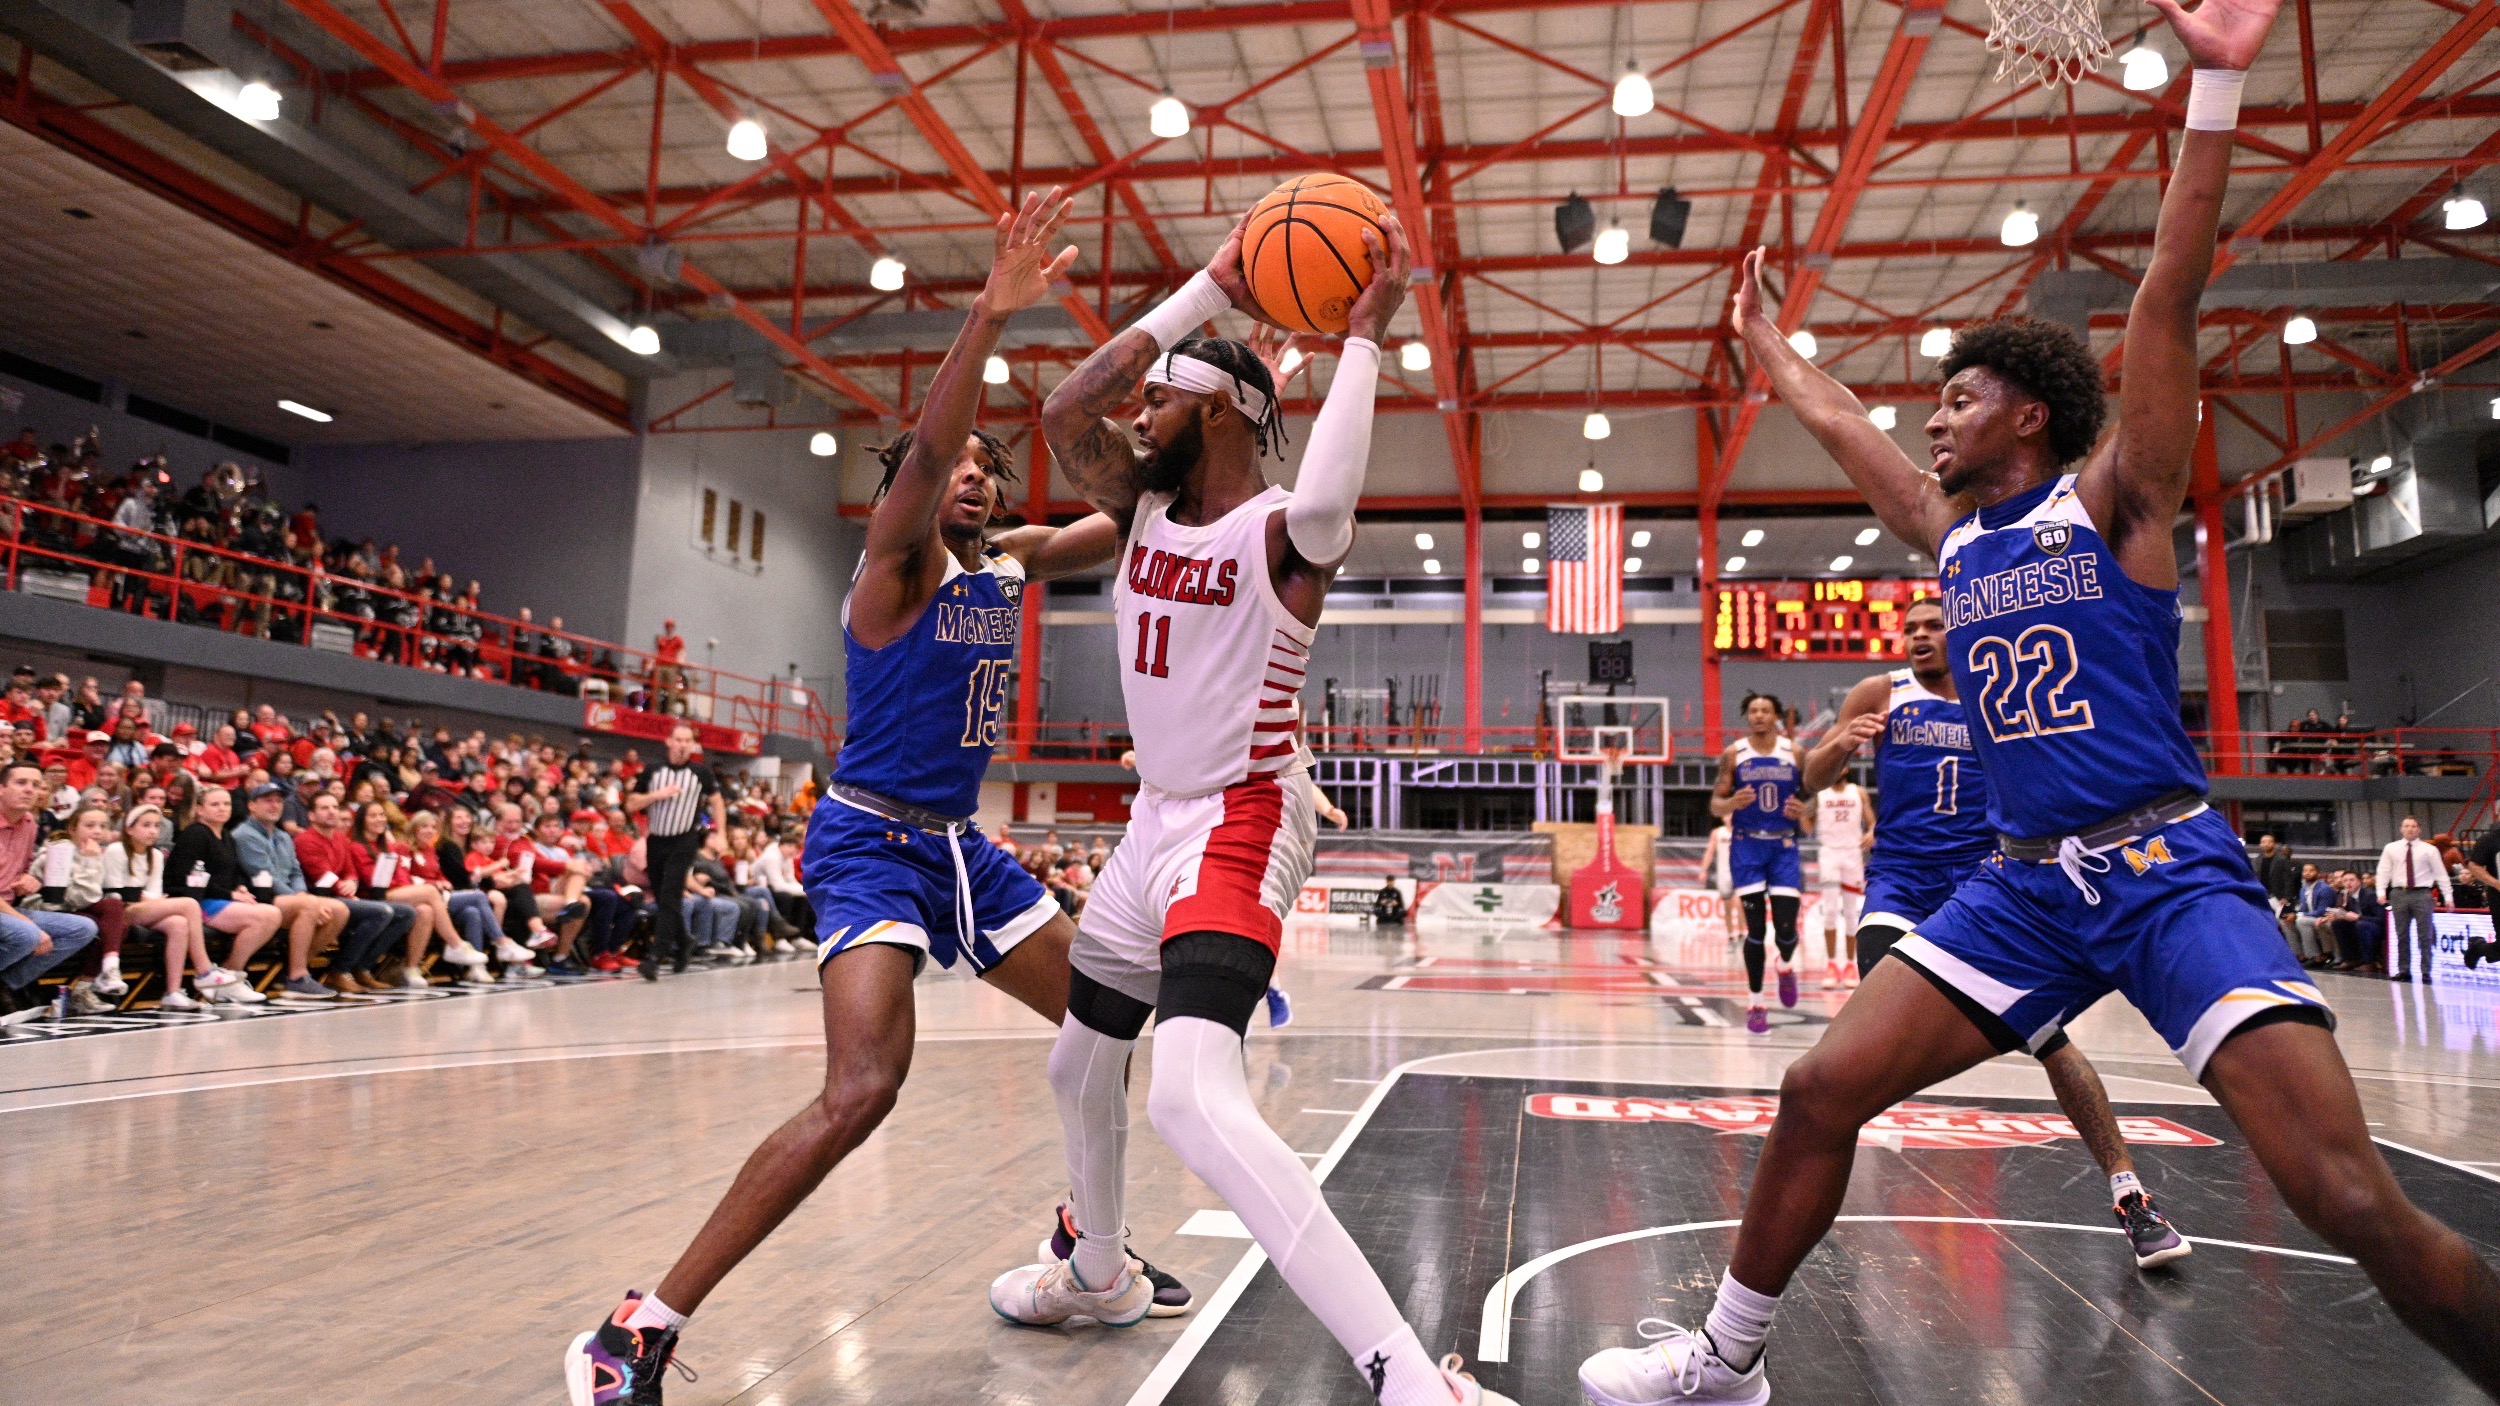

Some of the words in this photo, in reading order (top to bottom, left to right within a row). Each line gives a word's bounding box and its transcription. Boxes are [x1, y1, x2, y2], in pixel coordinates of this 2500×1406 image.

[2041, 529, 2067, 547] 60
[1005, 584, 1019, 598] 60
[1129, 540, 1238, 606] LONELS
[1942, 552, 2103, 633] McNEESE
[936, 603, 1020, 645] McNEES
[1134, 611, 1171, 678] 11
[961, 659, 1012, 747] 15
[1969, 624, 2095, 743] 22
[1891, 718, 1973, 750] McNEE
[1758, 781, 1779, 813] 0
[1934, 755, 1959, 816] 1
[1431, 852, 1477, 882] N
[2121, 835, 2179, 877] M
[1332, 891, 1379, 903] SEALEV
[1551, 1096, 2192, 1142] SOUTAND
